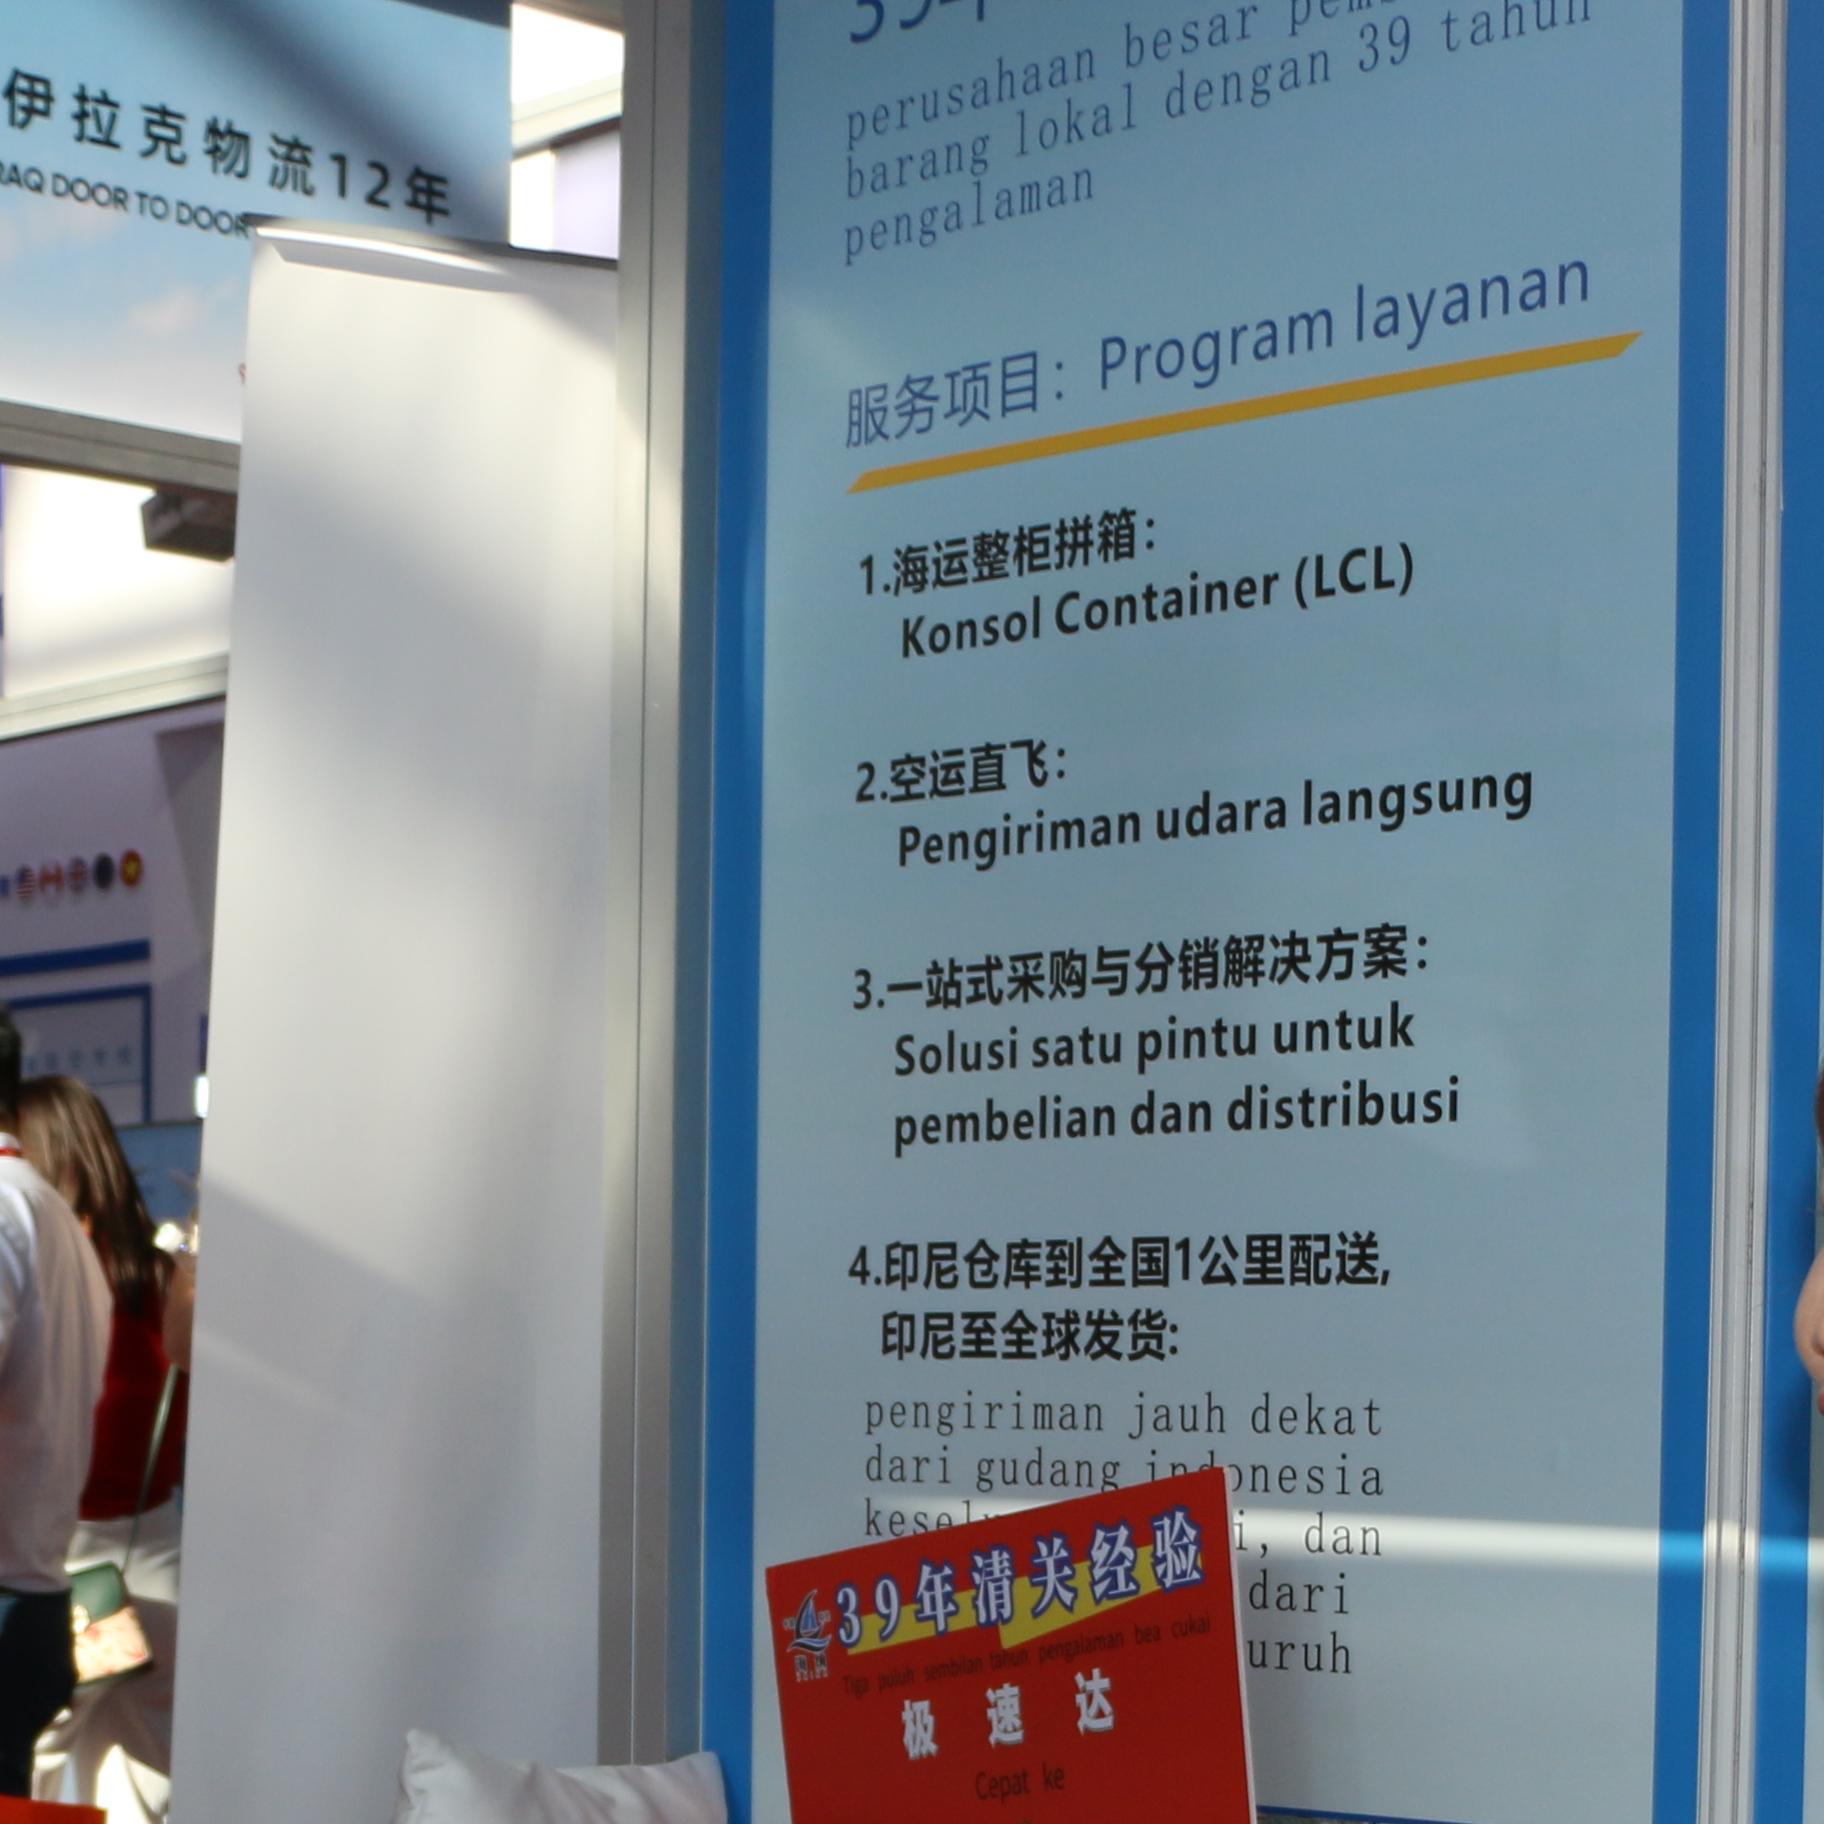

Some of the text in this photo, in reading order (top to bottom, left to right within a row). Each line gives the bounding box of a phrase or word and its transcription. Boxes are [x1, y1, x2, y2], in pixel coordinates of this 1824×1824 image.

[845, 135, 990, 198] barang
[1015, 82, 1138, 157] lokal
[1165, 50, 1332, 119] dengan
[1359, 15, 1410, 72] 39
[848, 47, 1095, 150] perusahaan
[1123, 4, 1259, 72] besar
[50, 173, 129, 212] DOOR
[135, 192, 170, 220] TO
[843, 168, 1095, 266] pengalaman
[845, 258, 1590, 448] 服务项目： Program layanan
[859, 507, 1156, 597] 1.海运整柜拼箱：
[901, 541, 1415, 659] Konsol Container (LCL)
[855, 738, 1066, 804] 2.空运直飞：
[897, 766, 1534, 872] Pengiriman udara langsung
[894, 1001, 1415, 1077] Solusi satu pintu untuk
[893, 1076, 1460, 1158] pembelian dan distribusi
[881, 1309, 1179, 1362] 印尼至全球发货:
[864, 1391, 1383, 1441] pengiriman jauh dekat
[864, 1444, 952, 1485] dari
[976, 1449, 1121, 1492] gudang
[1305, 1510, 1382, 1556] dan
[836, 1506, 1204, 1649] 39年清关经验
[1249, 1570, 1349, 1615] dari
[903, 1668, 1114, 1760] 极速达
[976, 1763, 1065, 1803] Cepat ke
